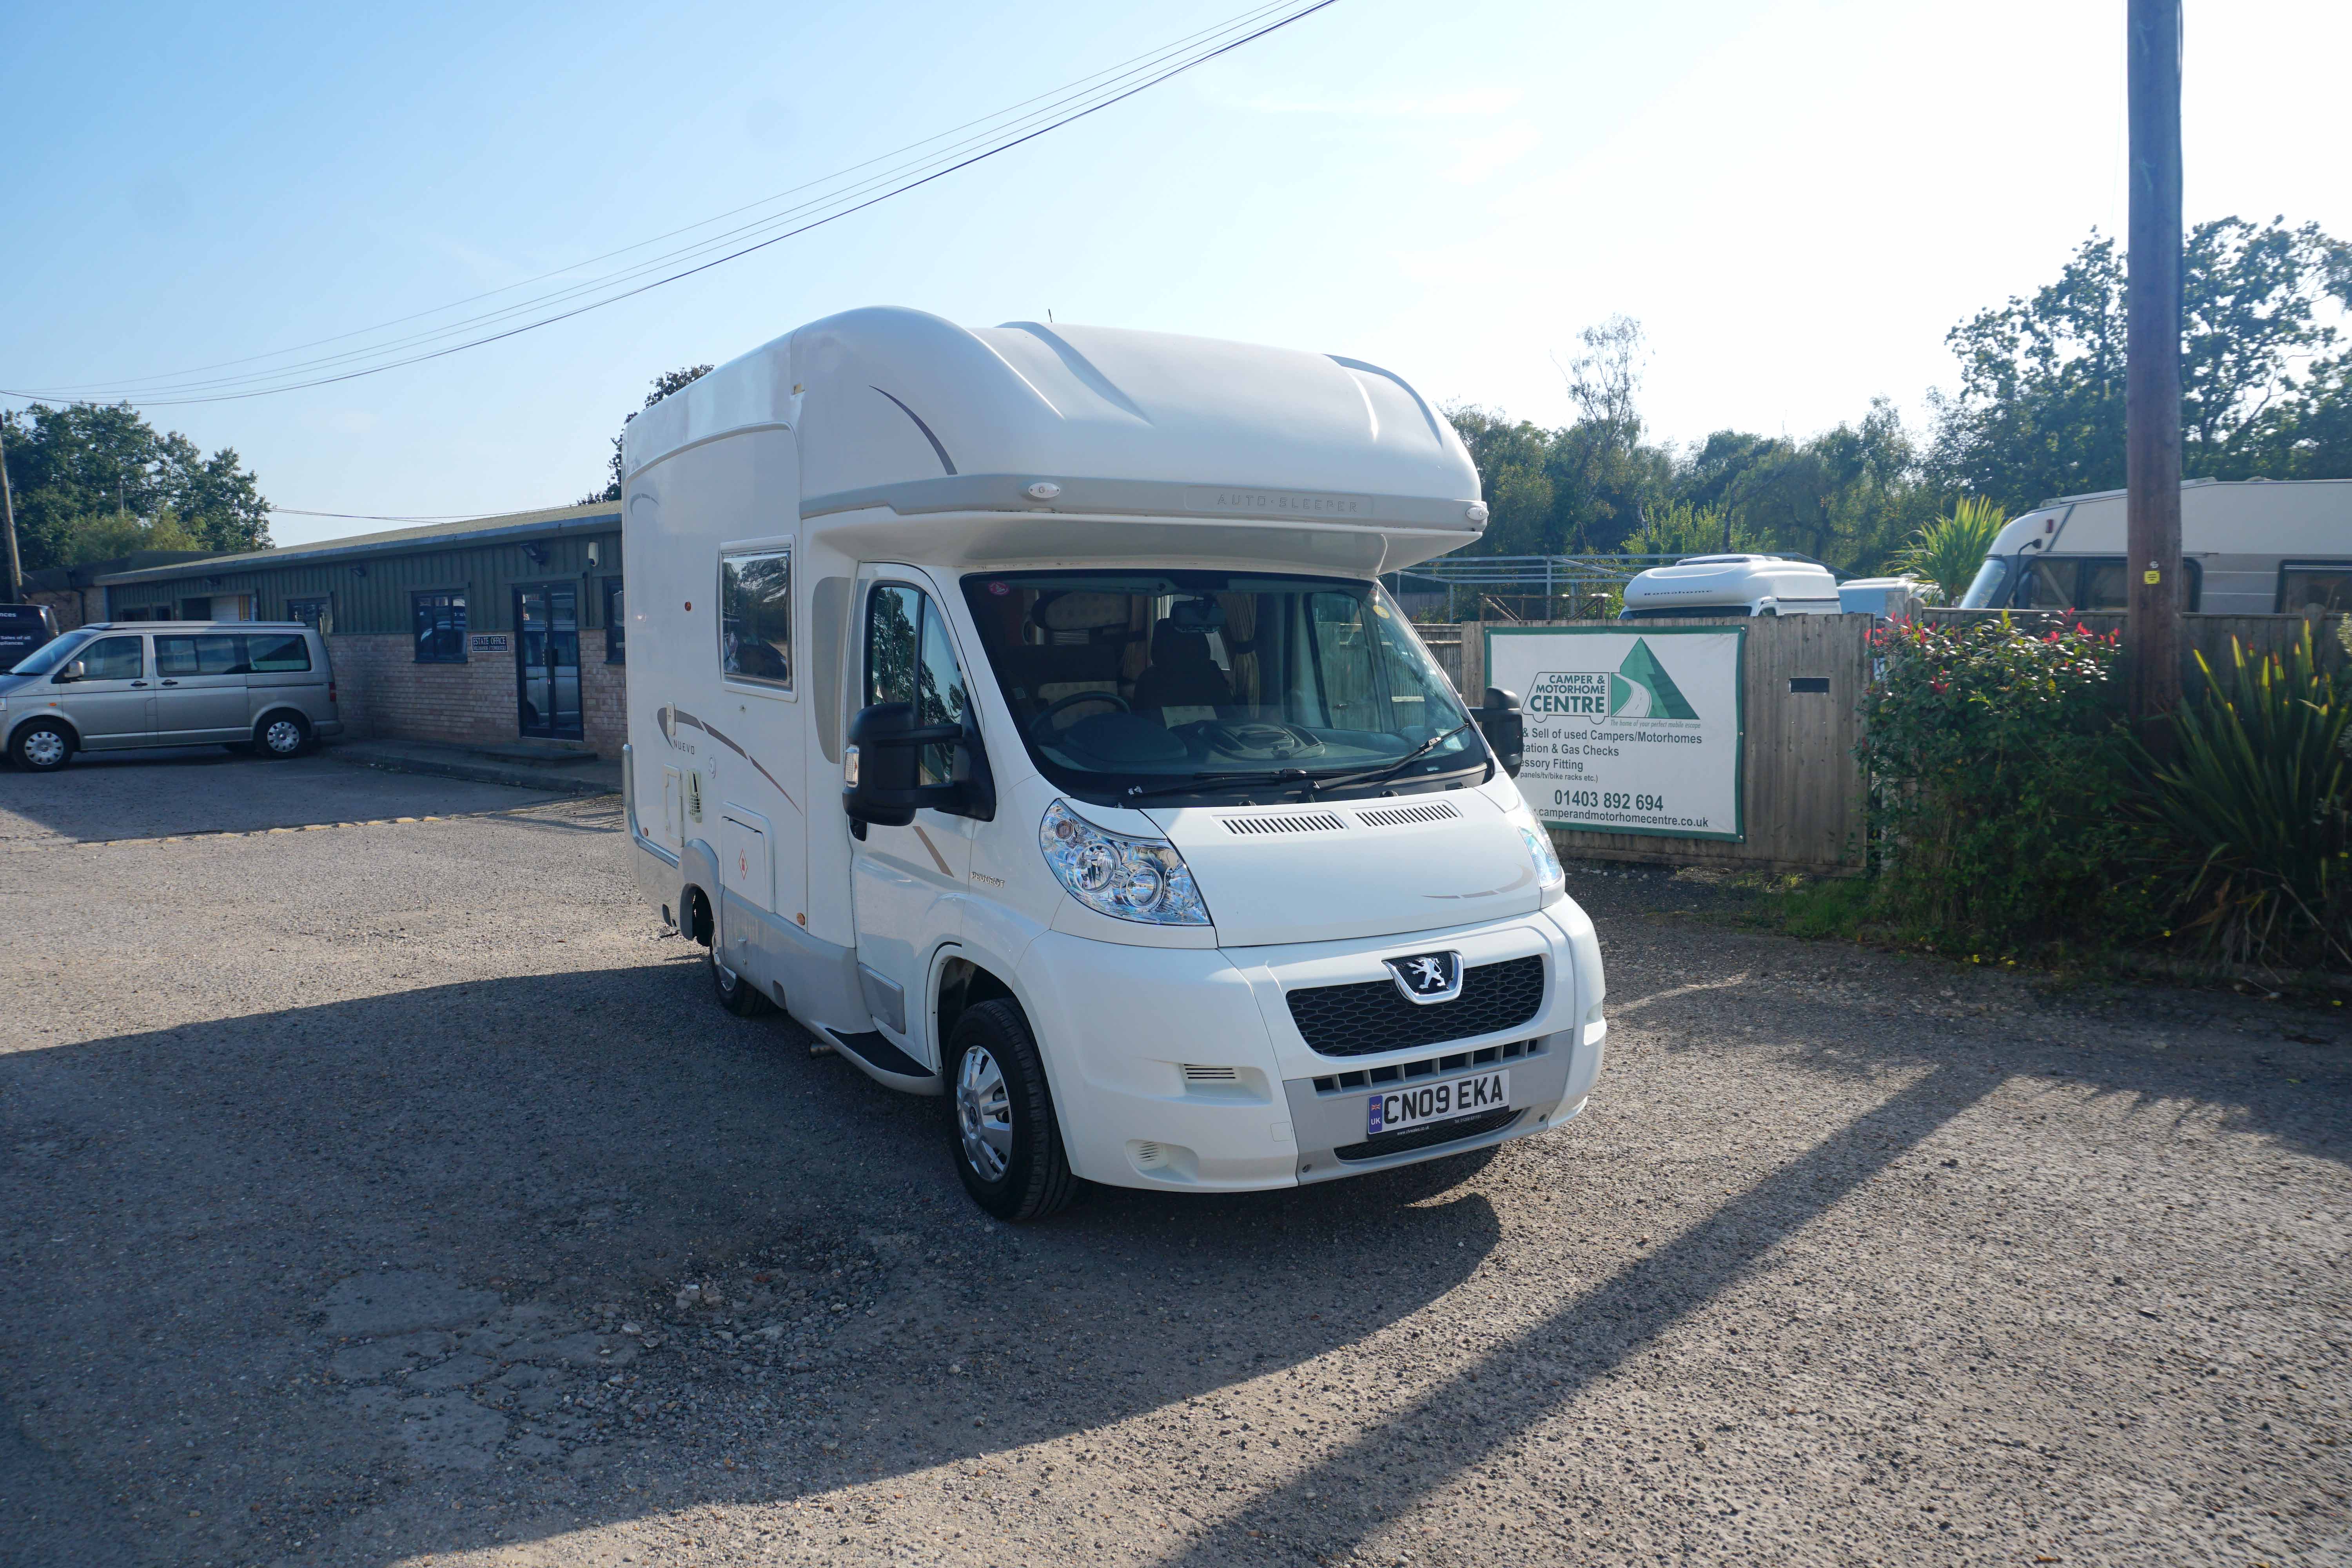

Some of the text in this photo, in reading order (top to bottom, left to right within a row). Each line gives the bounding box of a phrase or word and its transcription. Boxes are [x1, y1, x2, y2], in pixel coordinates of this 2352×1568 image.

[1549, 675, 1606, 684] CAMPER &
[1536, 684, 1606, 694] MOTORHOME
[1530, 695, 1605, 713] CENTRE
[1651, 720, 1667, 729] perfect
[1523, 727, 1702, 744] & Sell of used Campers/Motorhomes
[674, 740, 695, 755] NUEVO
[1523, 743, 1619, 756] tation & Gas Checks
[1521, 759, 1583, 772] essory Fitting
[1521, 771, 1563, 780] panels/tv/bike
[1584, 774, 1599, 783] etc.)
[1554, 789, 1664, 811] 01403 892 694
[1534, 808, 1709, 828] .camperandmotorhomecentre.co.uk
[1384, 1074, 1503, 1124] CN09 EKA
